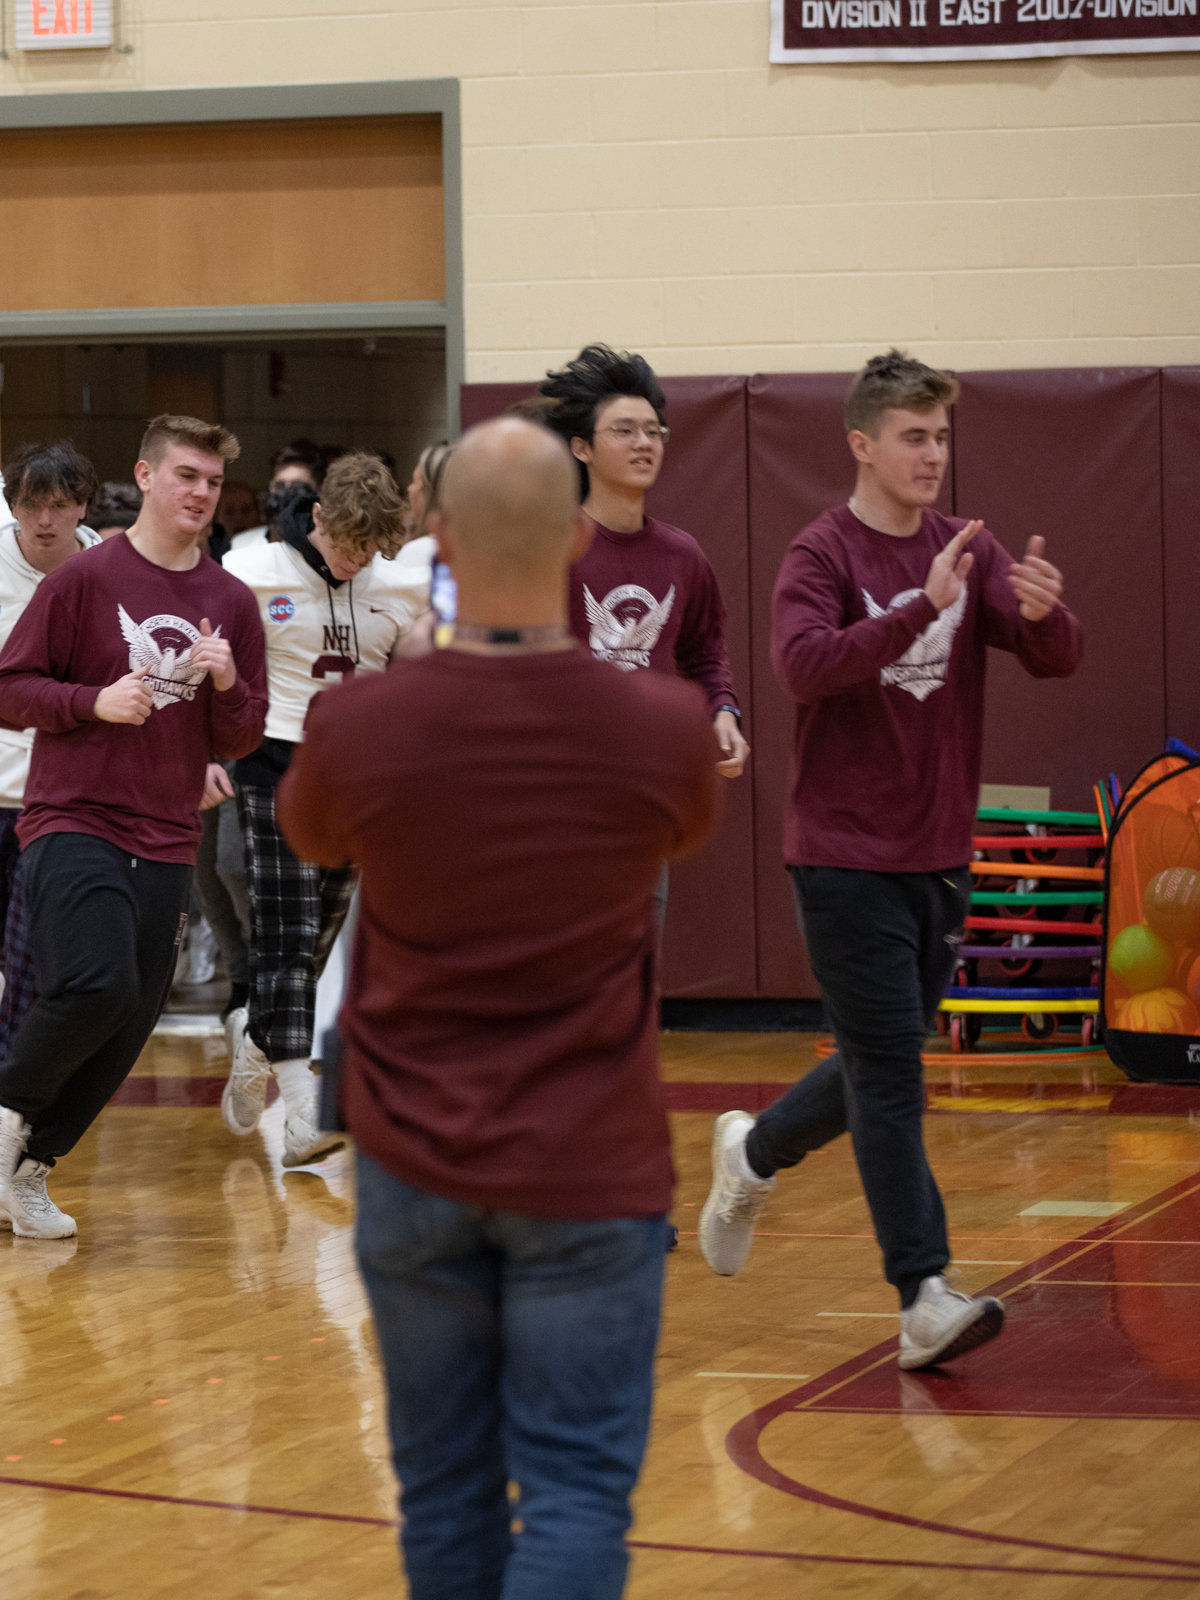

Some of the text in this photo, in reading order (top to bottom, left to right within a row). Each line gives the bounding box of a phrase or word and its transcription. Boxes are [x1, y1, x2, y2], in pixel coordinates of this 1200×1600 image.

[31, 0, 93, 35] EXIT
[802, 0, 900, 29] DIVISION
[909, 0, 927, 27] II
[939, 0, 1003, 27] EAST
[269, 603, 296, 616] SCC
[323, 625, 351, 651] NH
